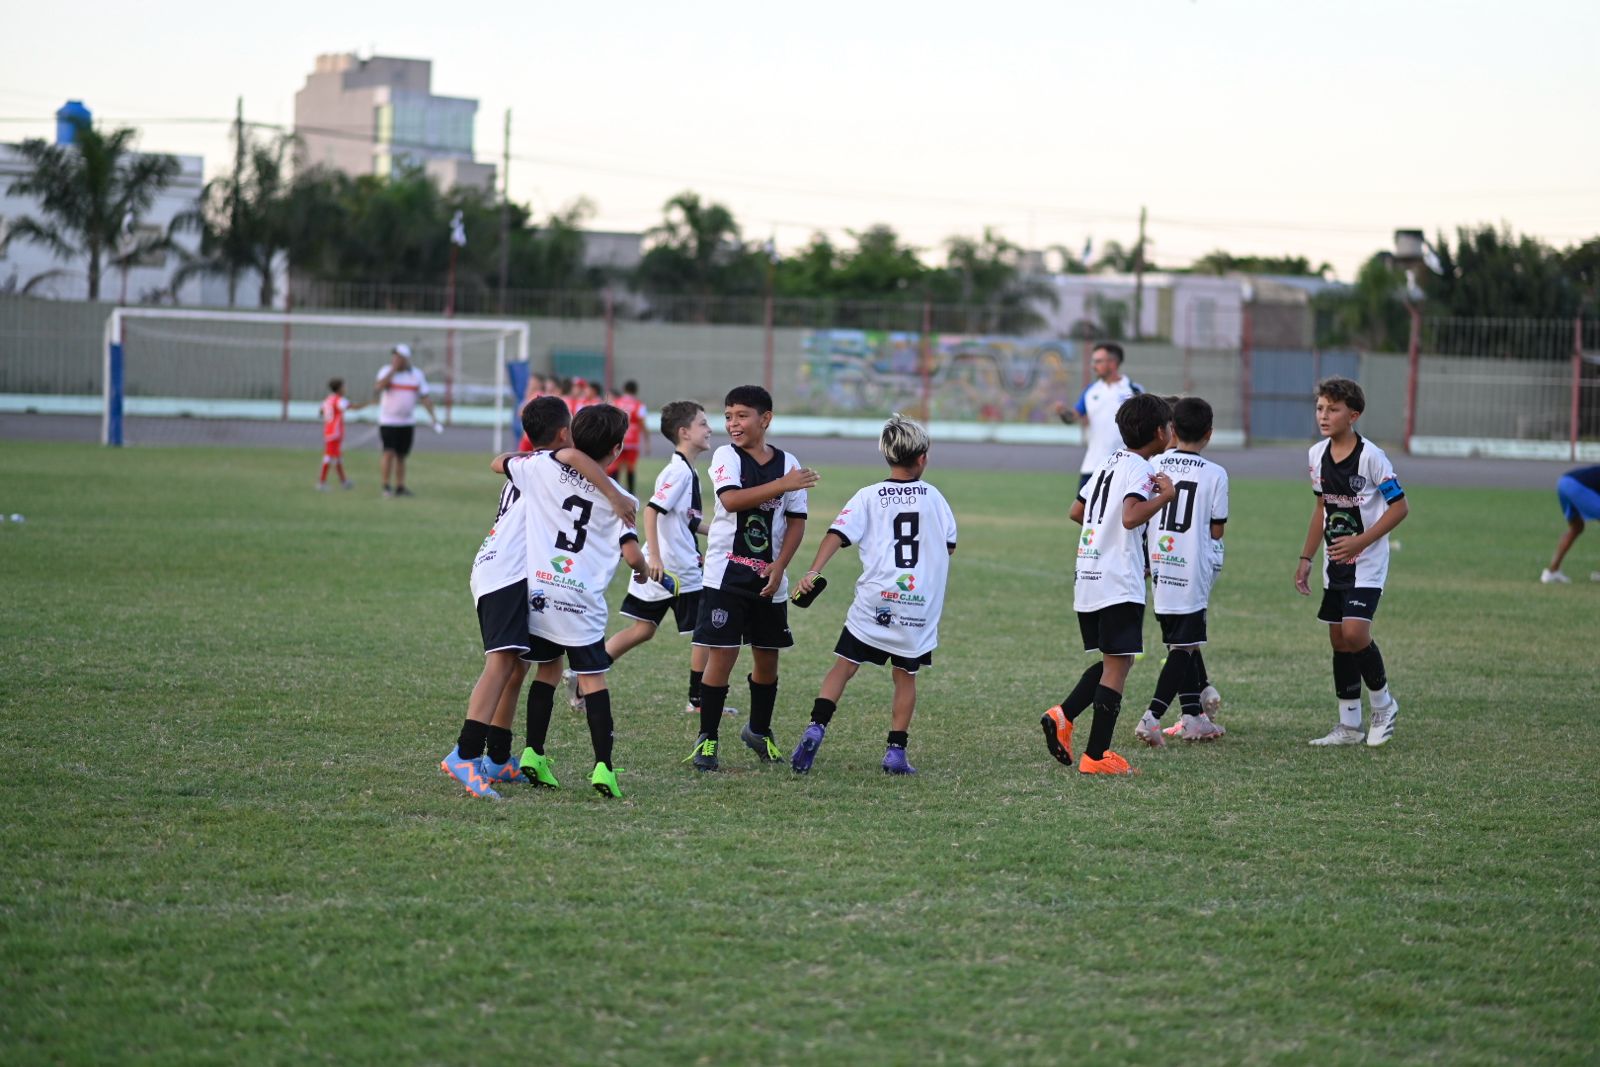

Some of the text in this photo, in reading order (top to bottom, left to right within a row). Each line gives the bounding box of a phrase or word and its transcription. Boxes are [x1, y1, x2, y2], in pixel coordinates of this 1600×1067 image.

[1160, 457, 1207, 469] devenir
[1160, 465, 1191, 476] group
[559, 472, 596, 493] group
[878, 485, 928, 497] devenir
[880, 495, 917, 509] group
[1086, 470, 1114, 524] 11
[1159, 480, 1198, 533] 10
[555, 494, 594, 554] 3
[893, 512, 920, 569] 8
[535, 570, 588, 590] RED C.I.M.A.
[880, 591, 899, 600] RED
